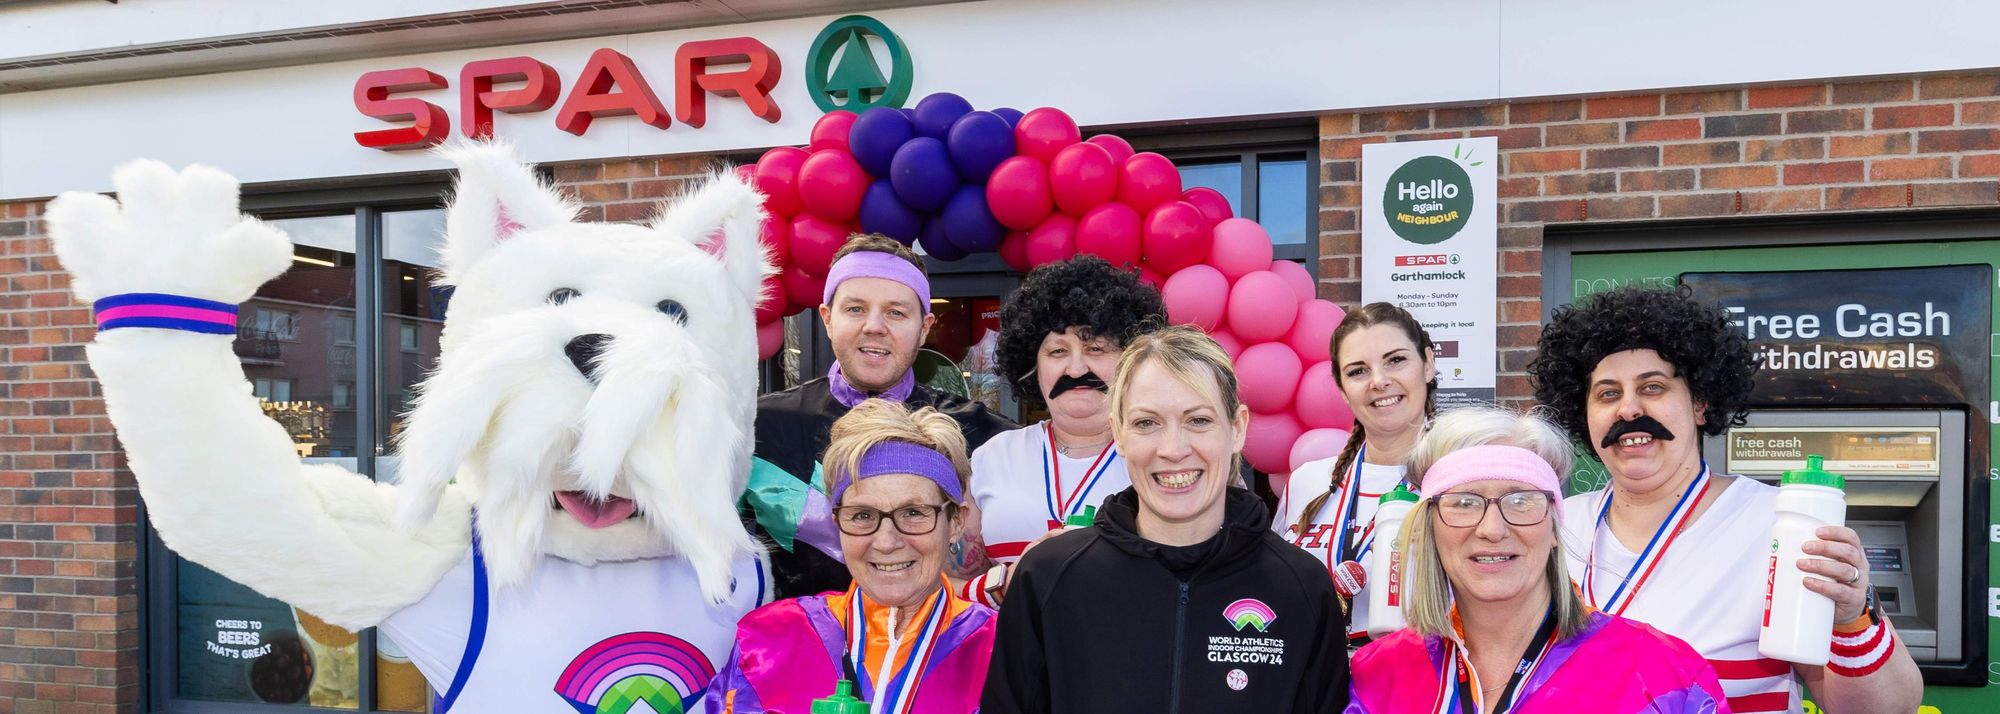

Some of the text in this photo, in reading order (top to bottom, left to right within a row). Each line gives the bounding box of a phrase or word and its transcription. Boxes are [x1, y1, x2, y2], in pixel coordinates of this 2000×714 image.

[353, 36, 782, 151] SPAR
[1398, 179, 1459, 200] Hello
[1412, 201, 1443, 214] again
[1397, 211, 1459, 225] NEIGHBOUR
[1407, 256, 1446, 264] SPAR
[1391, 270, 1466, 281] Garthamlock
[981, 311, 1001, 319] PRIC
[1723, 302, 1951, 340] Free Cash
[1736, 437, 1802, 448] free cash
[1735, 449, 1802, 458] withdrawals
[1390, 551, 1400, 594] SPAR
[216, 620, 262, 629] CHEERS TO
[218, 631, 260, 645] BEERS
[1242, 638, 1284, 647] ATHLETICS
[206, 640, 272, 659] THAT'S GREAT
[1235, 646, 1284, 654] CHAMPIONSHIPS
[1208, 652, 1283, 665] GLASGOW 24
